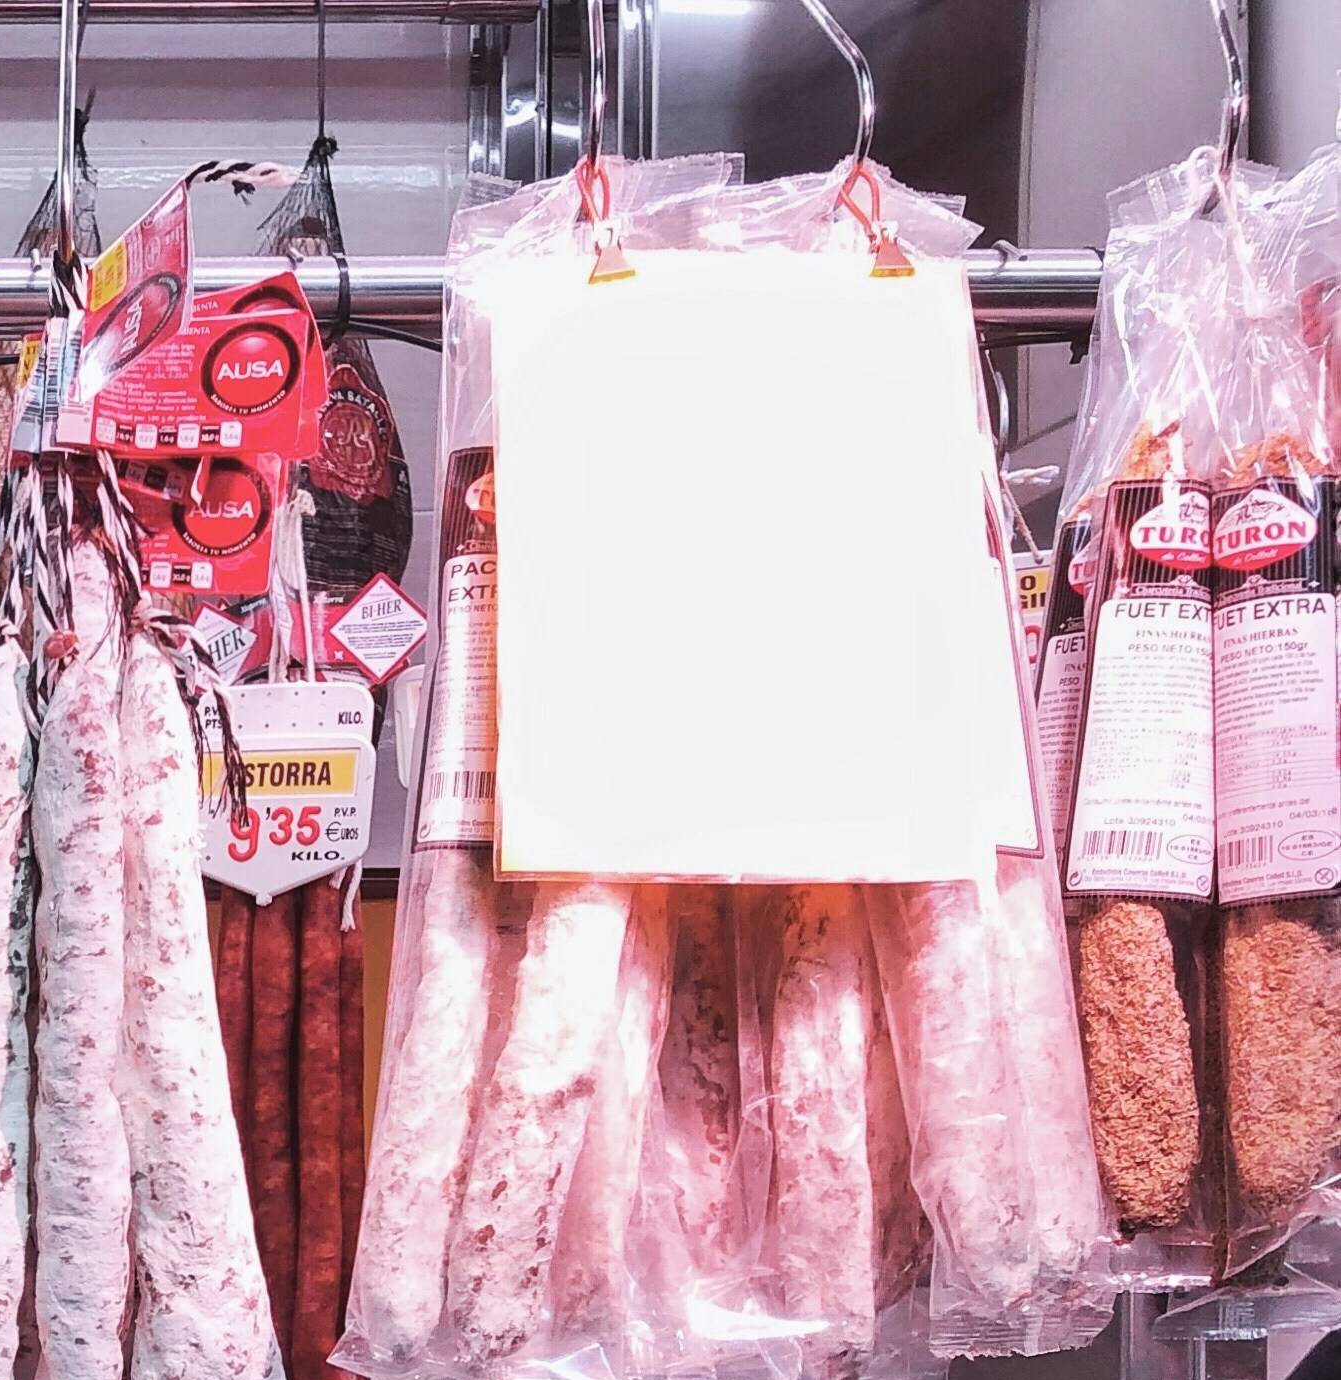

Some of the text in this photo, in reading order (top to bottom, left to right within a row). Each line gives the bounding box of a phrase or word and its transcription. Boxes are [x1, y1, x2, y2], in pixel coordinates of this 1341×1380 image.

[121, 296, 145, 353] AUSA
[217, 359, 285, 381] AUSA
[188, 500, 255, 519] AUSA
[1214, 520, 1308, 556] TURON
[450, 560, 497, 579] PAC
[1114, 602, 1213, 623] FUET EXT
[1253, 597, 1327, 621] EXTRA
[1170, 630, 1211, 642] HIERBA
[1222, 627, 1299, 650] FINAS HIERBAS
[1128, 643, 1193, 654] PESO NETO
[1220, 651, 1241, 664] PESO
[1244, 644, 1274, 658] NETO
[1059, 676, 1080, 687] PESO
[337, 711, 364, 725] KILO.
[243, 761, 332, 788] STORRA
[290, 849, 346, 862] KILO.
